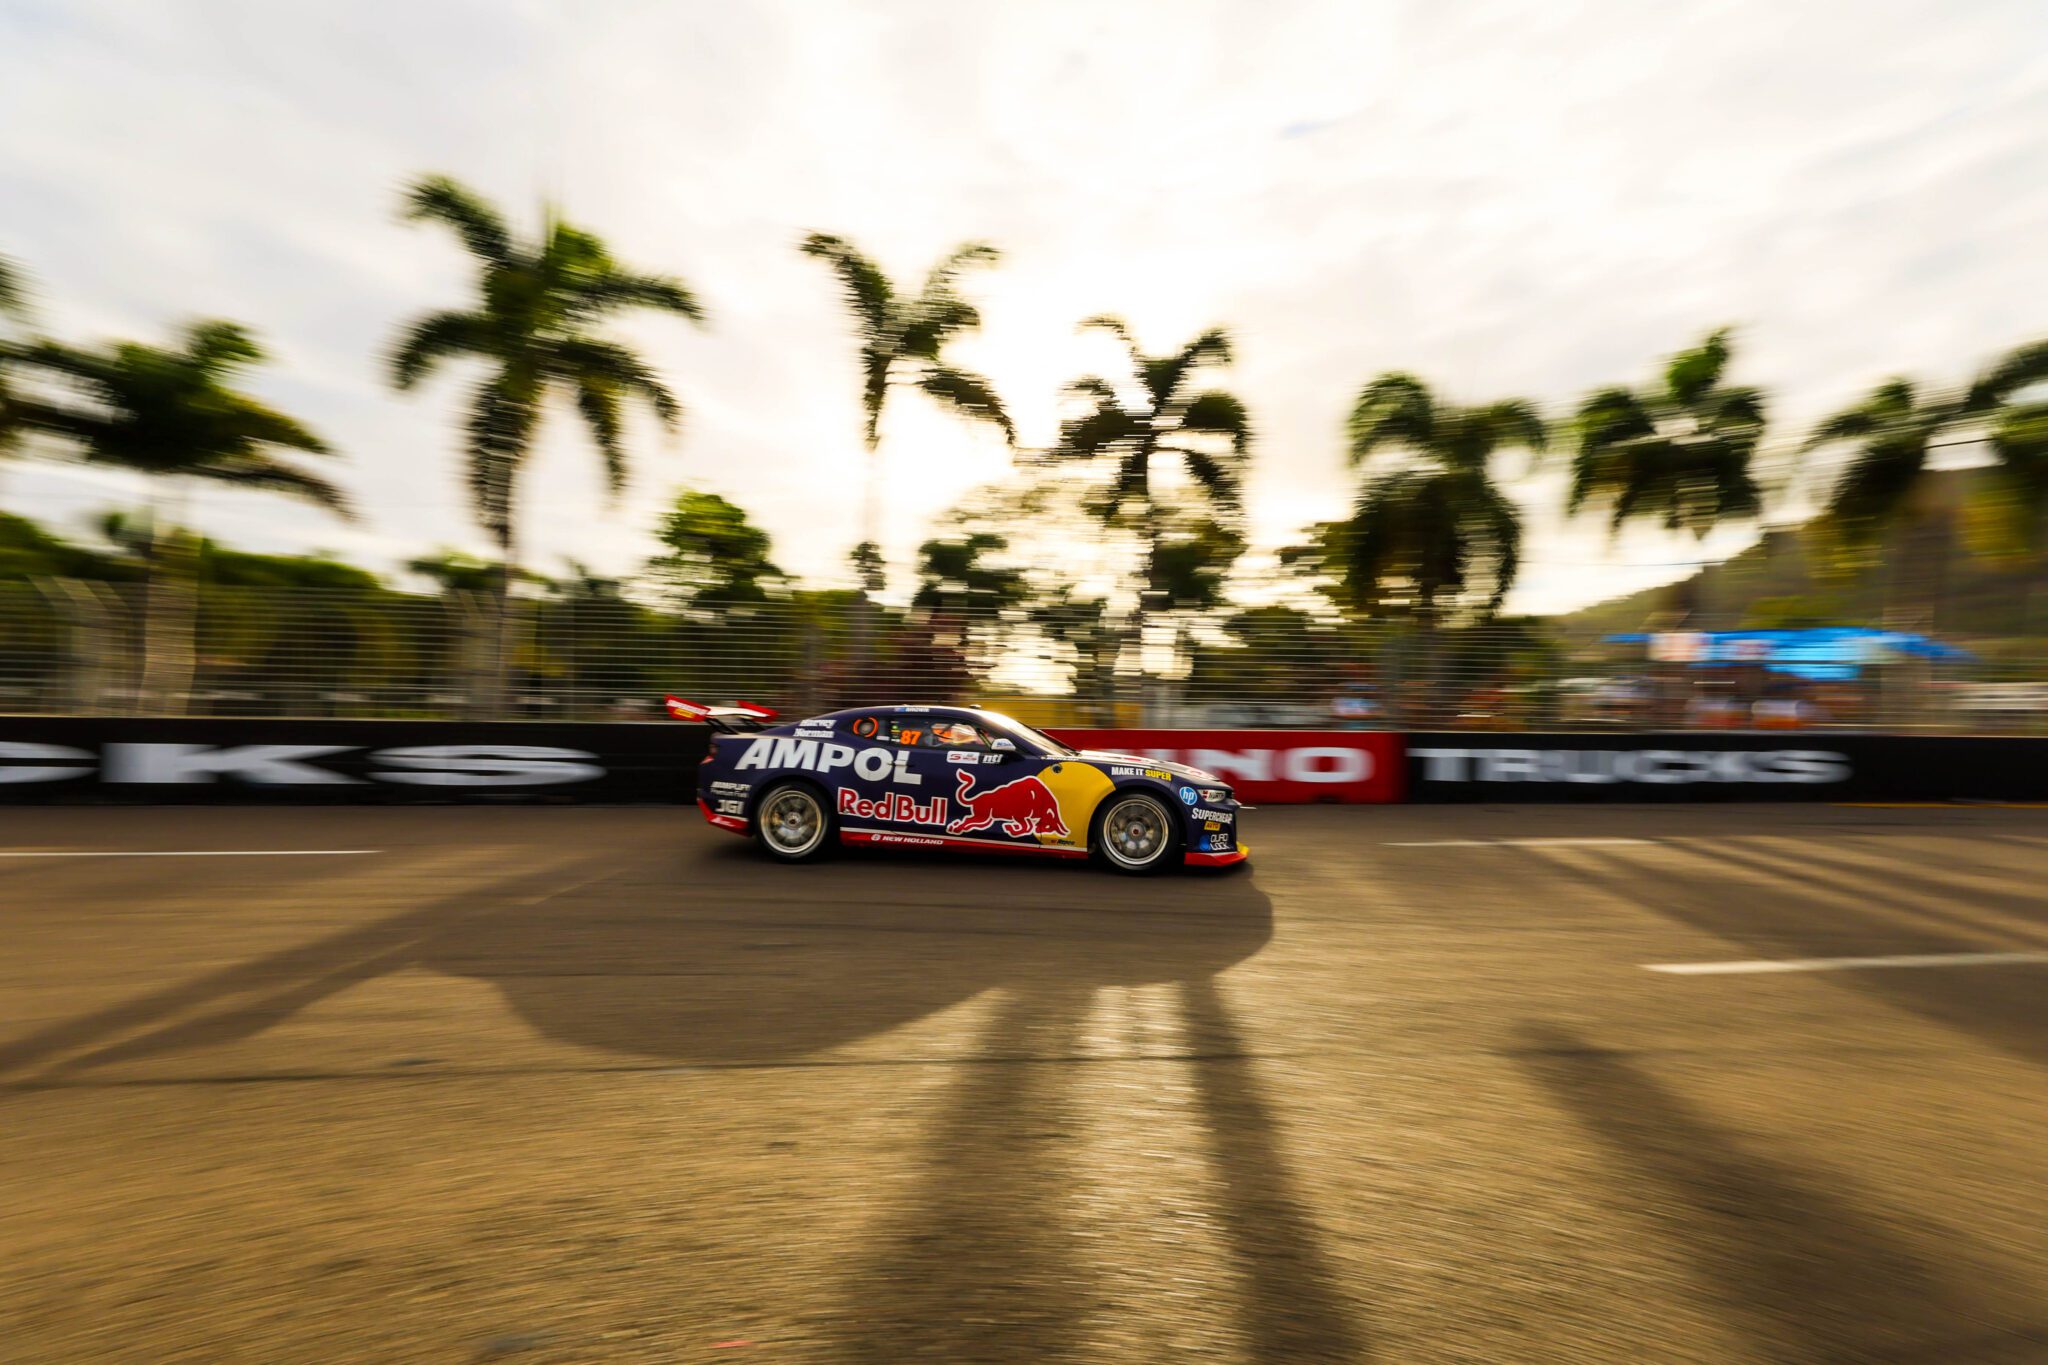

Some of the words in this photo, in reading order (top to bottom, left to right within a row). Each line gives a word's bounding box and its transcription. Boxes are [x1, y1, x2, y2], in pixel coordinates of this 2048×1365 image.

[900, 729, 922, 745] 87
[734, 737, 922, 785] AMPOL
[1108, 748, 1377, 783] NO
[1405, 748, 1854, 784] TRUCKS
[1111, 766, 1134, 776] MAKE
[1135, 768, 1144, 776] IT
[1145, 769, 1172, 781] SUPER
[838, 787, 894, 821] Red
[895, 795, 948, 826] Bull
[1191, 807, 1233, 824] SUPERCHEAP
[903, 837, 944, 845] HOLLAND
[1210, 842, 1231, 851] LOCK
[1211, 833, 1229, 844] QUAD
